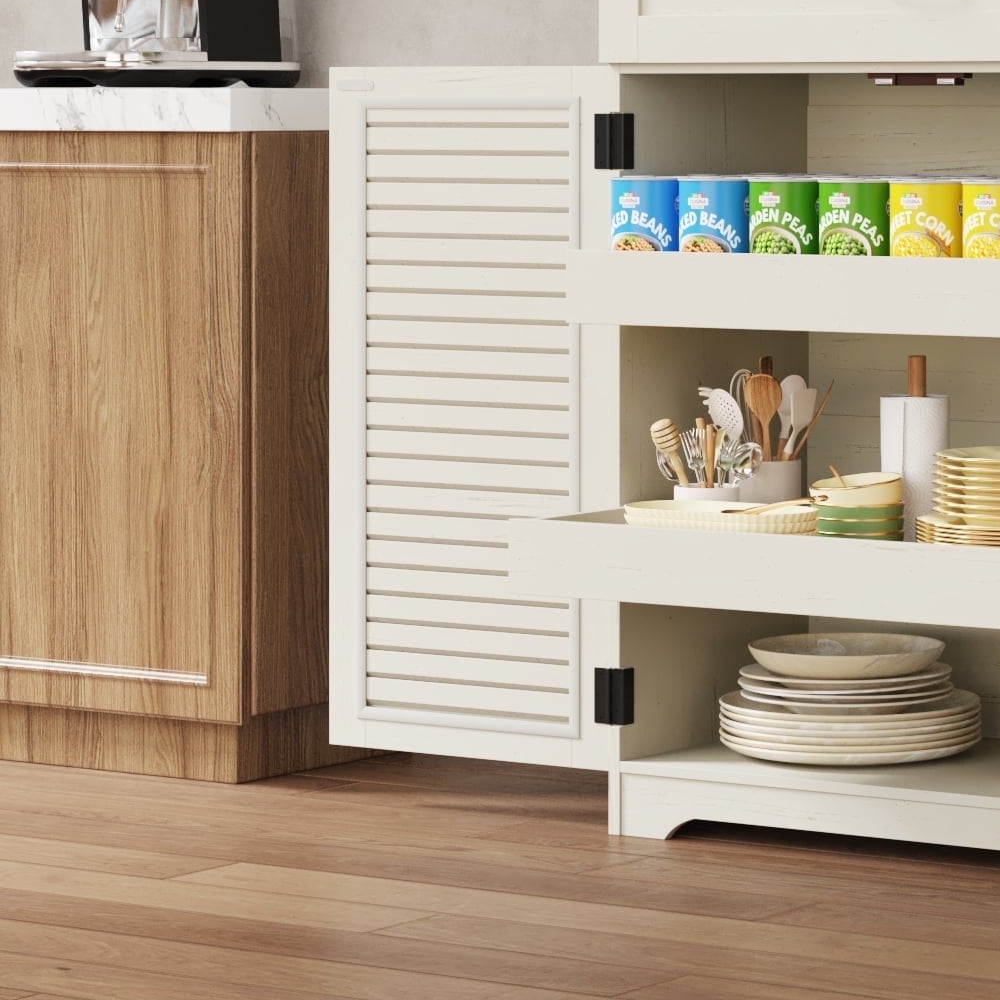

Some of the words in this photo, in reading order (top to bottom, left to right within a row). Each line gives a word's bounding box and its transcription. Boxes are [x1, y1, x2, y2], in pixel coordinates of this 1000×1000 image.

[631, 209, 672, 247] BEANS
[700, 210, 741, 248] BEANS
[781, 211, 813, 245] PEAS
[851, 212, 884, 247] PEAS
[915, 211, 954, 246] CORN
